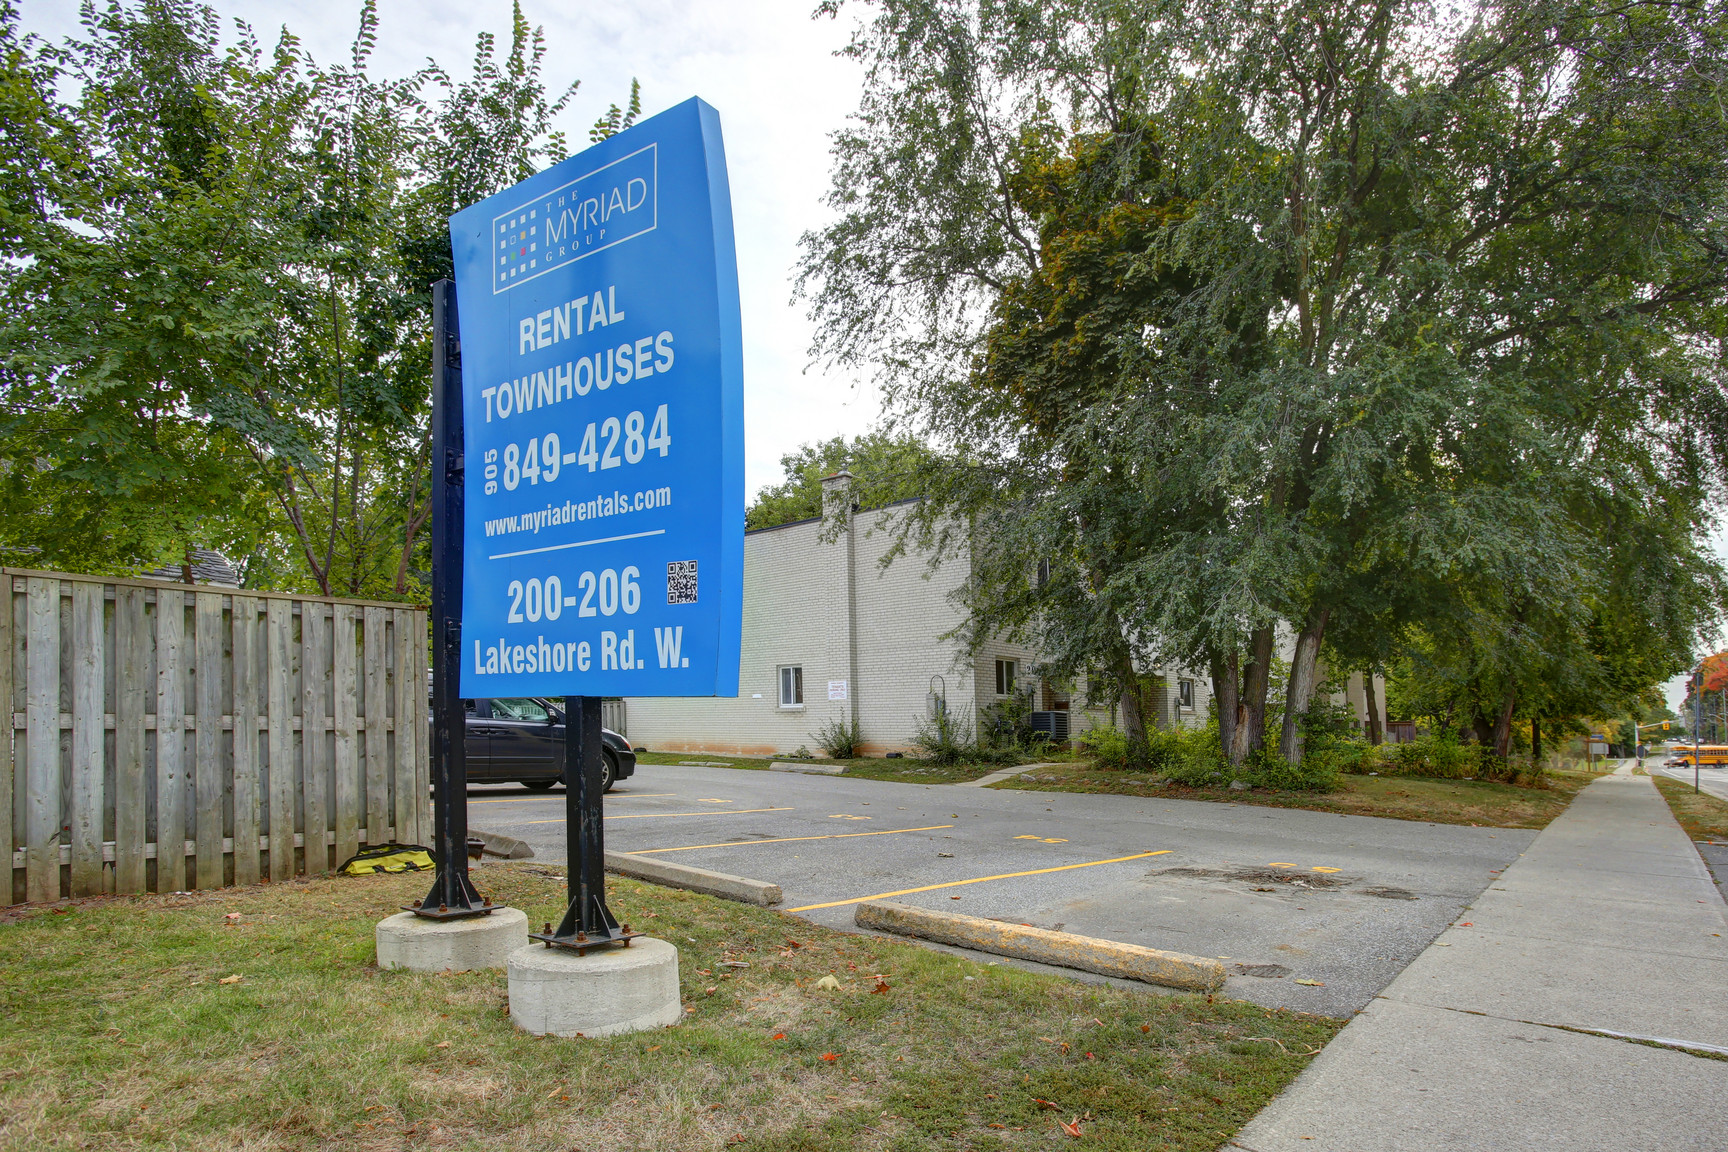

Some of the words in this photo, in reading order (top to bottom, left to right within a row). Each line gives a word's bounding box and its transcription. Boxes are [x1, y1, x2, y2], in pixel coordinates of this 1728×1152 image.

[545, 190, 578, 212] THE
[546, 177, 647, 247] MYRIAD
[545, 228, 606, 262] GROUP
[519, 285, 625, 356] RENTAL
[482, 330, 675, 423] TOWNHOUSES
[484, 448, 498, 496] 905
[503, 403, 671, 491] 849-4284
[484, 486, 671, 537] www.myriadrentals.com
[507, 565, 641, 624] 200-206
[474, 635, 591, 675] Lakeshore
[601, 629, 645, 671] Rd.
[654, 625, 690, 669] W.
